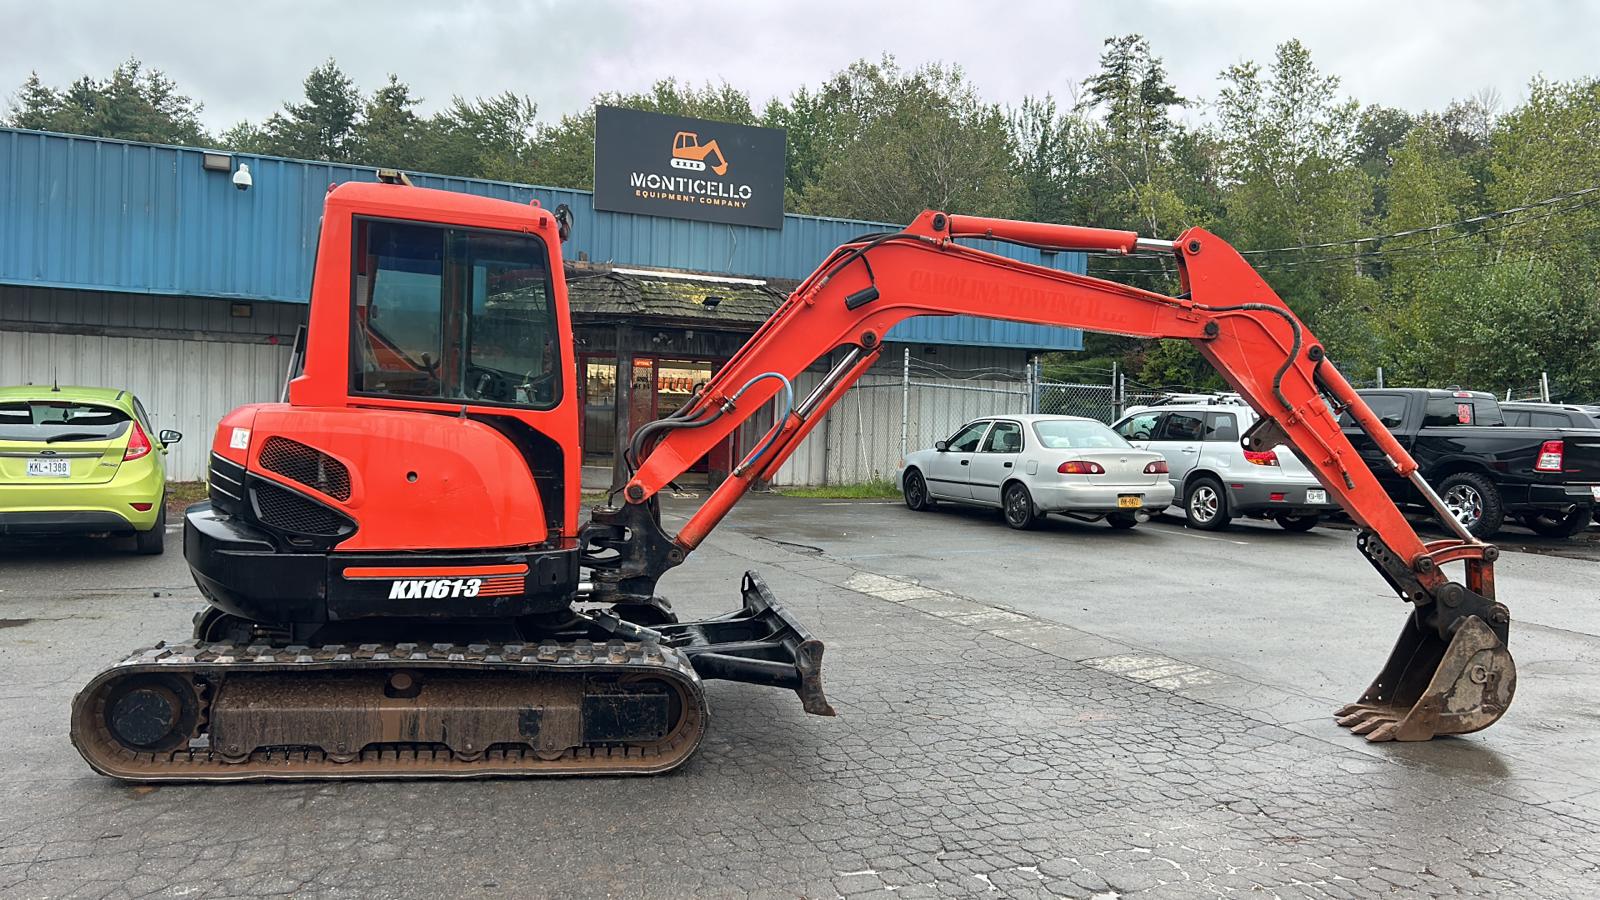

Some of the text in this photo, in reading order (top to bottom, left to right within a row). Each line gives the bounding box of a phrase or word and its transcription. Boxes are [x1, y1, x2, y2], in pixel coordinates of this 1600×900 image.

[630, 172, 752, 199] MONTICELLO
[635, 189, 747, 208] EQUIPMENT COMPANY
[388, 578, 482, 600] KX161-3
